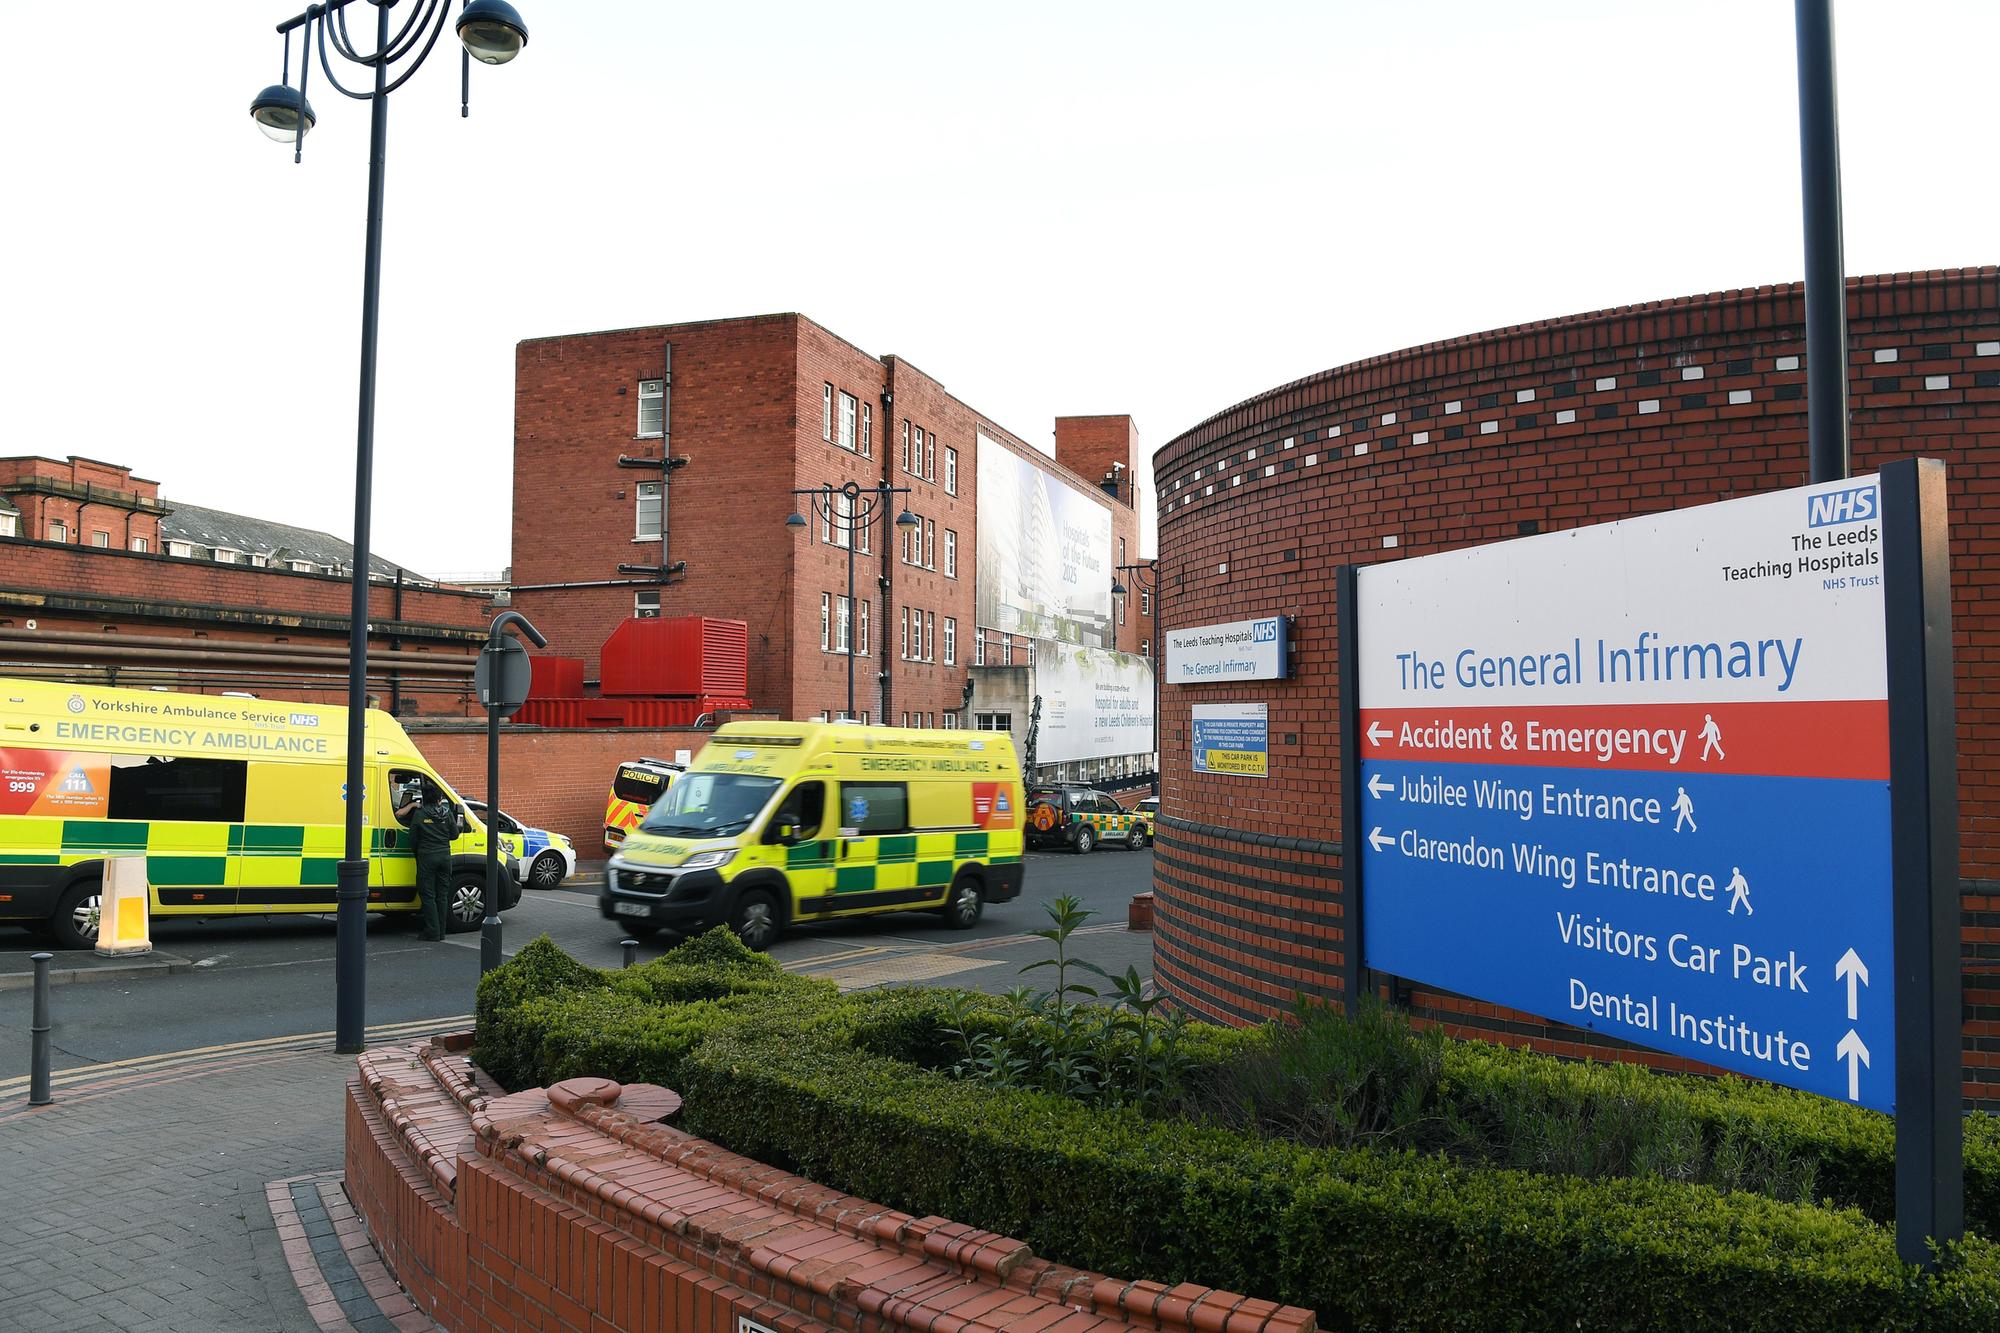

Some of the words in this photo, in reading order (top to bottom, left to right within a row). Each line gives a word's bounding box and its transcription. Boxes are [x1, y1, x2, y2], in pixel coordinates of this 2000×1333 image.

[1810, 488, 1874, 525] NHS
[1063, 520, 1090, 547] Hospitals
[1792, 534, 1822, 551] The
[1828, 525, 1878, 547] Leeds
[1063, 542, 1070, 560] of
[1071, 544, 1081, 565] the
[1082, 550, 1100, 572] Future
[1722, 560, 1792, 581] Teaching
[1799, 548, 1879, 573] Hospitals
[1063, 563, 1077, 584] 2025
[1823, 577, 1846, 590] NHS
[1850, 575, 1879, 588] Trust
[1174, 638, 1182, 649] The
[1183, 637, 1198, 648] Leeds
[1199, 635, 1224, 647] Teaching
[1225, 630, 1252, 645] Hospitals
[1254, 621, 1276, 641] NHS
[1183, 664, 1194, 676] The
[1195, 660, 1221, 675] General
[1223, 659, 1257, 674] Infirmary
[1397, 650, 1445, 690] The
[1455, 638, 1582, 689] General
[1598, 632, 1803, 691] Infirmary
[92, 699, 158, 714] Yorkshire
[163, 705, 237, 720] Ambulance
[242, 710, 286, 723] Service
[290, 714, 318, 726] NHS
[1098, 717, 1108, 727] new
[1108, 714, 1120, 727] Leeds
[56, 722, 196, 745] EMERGENCY
[202, 732, 327, 753] AMBULANCE
[1399, 720, 1492, 750] Accident
[1500, 721, 1518, 750] &
[1527, 722, 1687, 764] Emergency
[623, 770, 659, 784] POLICE
[861, 758, 927, 771] EMERGENCY
[930, 760, 990, 773] AMBULANCE
[1217, 762, 1240, 770] MONITORED
[1241, 763, 1247, 771] BY
[9, 781, 35, 793] 999
[65, 780, 87, 791] 111
[1400, 775, 1467, 807] Jubilee
[1473, 779, 1533, 820] Wing
[1542, 784, 1661, 824] Entrance
[1400, 830, 1504, 871] Clarendon
[1512, 843, 1576, 889] Wing
[1587, 852, 1715, 901] Entrance
[1557, 912, 1657, 963] Visitors
[1668, 933, 1721, 975] Car
[1733, 943, 1809, 993] Park
[1569, 978, 1658, 1031] Dental
[1670, 1002, 1811, 1071] Institute
